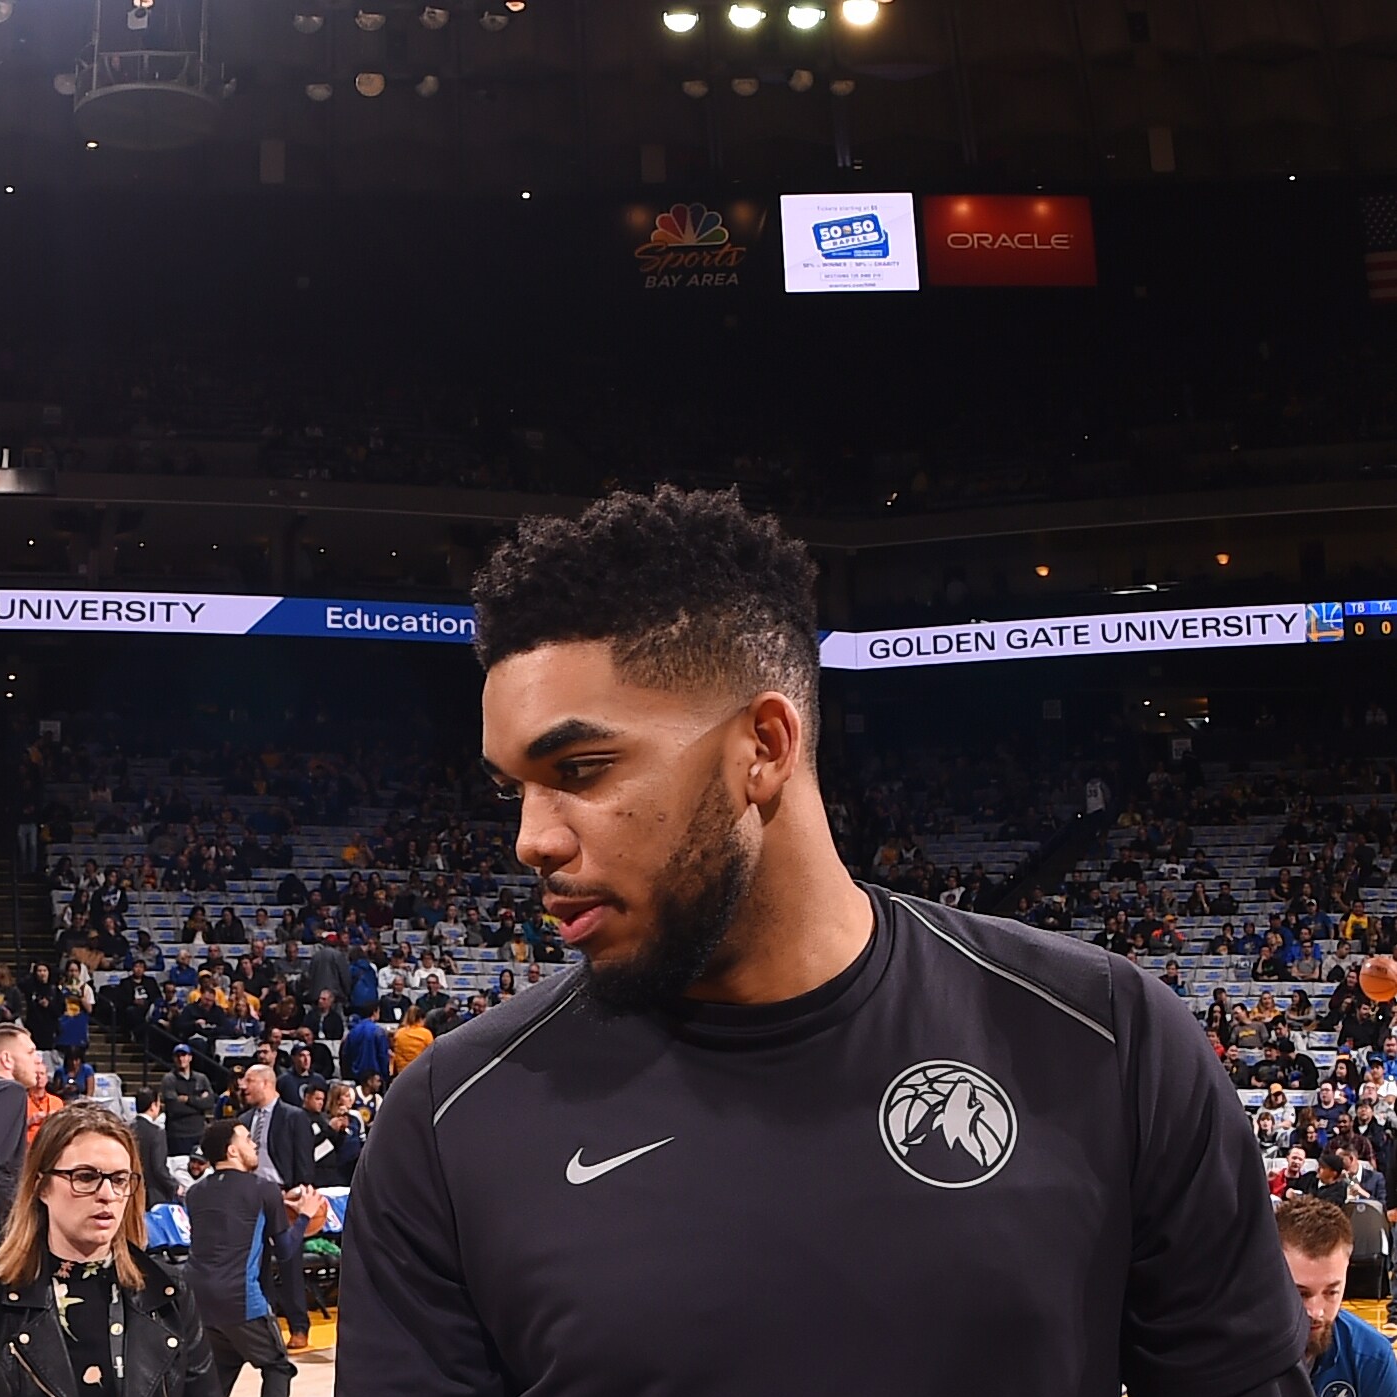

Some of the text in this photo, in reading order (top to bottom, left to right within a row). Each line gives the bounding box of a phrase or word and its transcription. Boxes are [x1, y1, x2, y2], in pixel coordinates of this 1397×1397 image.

[947, 233, 1070, 249] ORACLE
[634, 242, 746, 276] Sports
[645, 272, 739, 288] BAY AREA
[326, 606, 476, 635] Education
[1354, 620, 1391, 635] 0 0
[868, 612, 1299, 660] GOLDEN GATE UNIVERSITY
